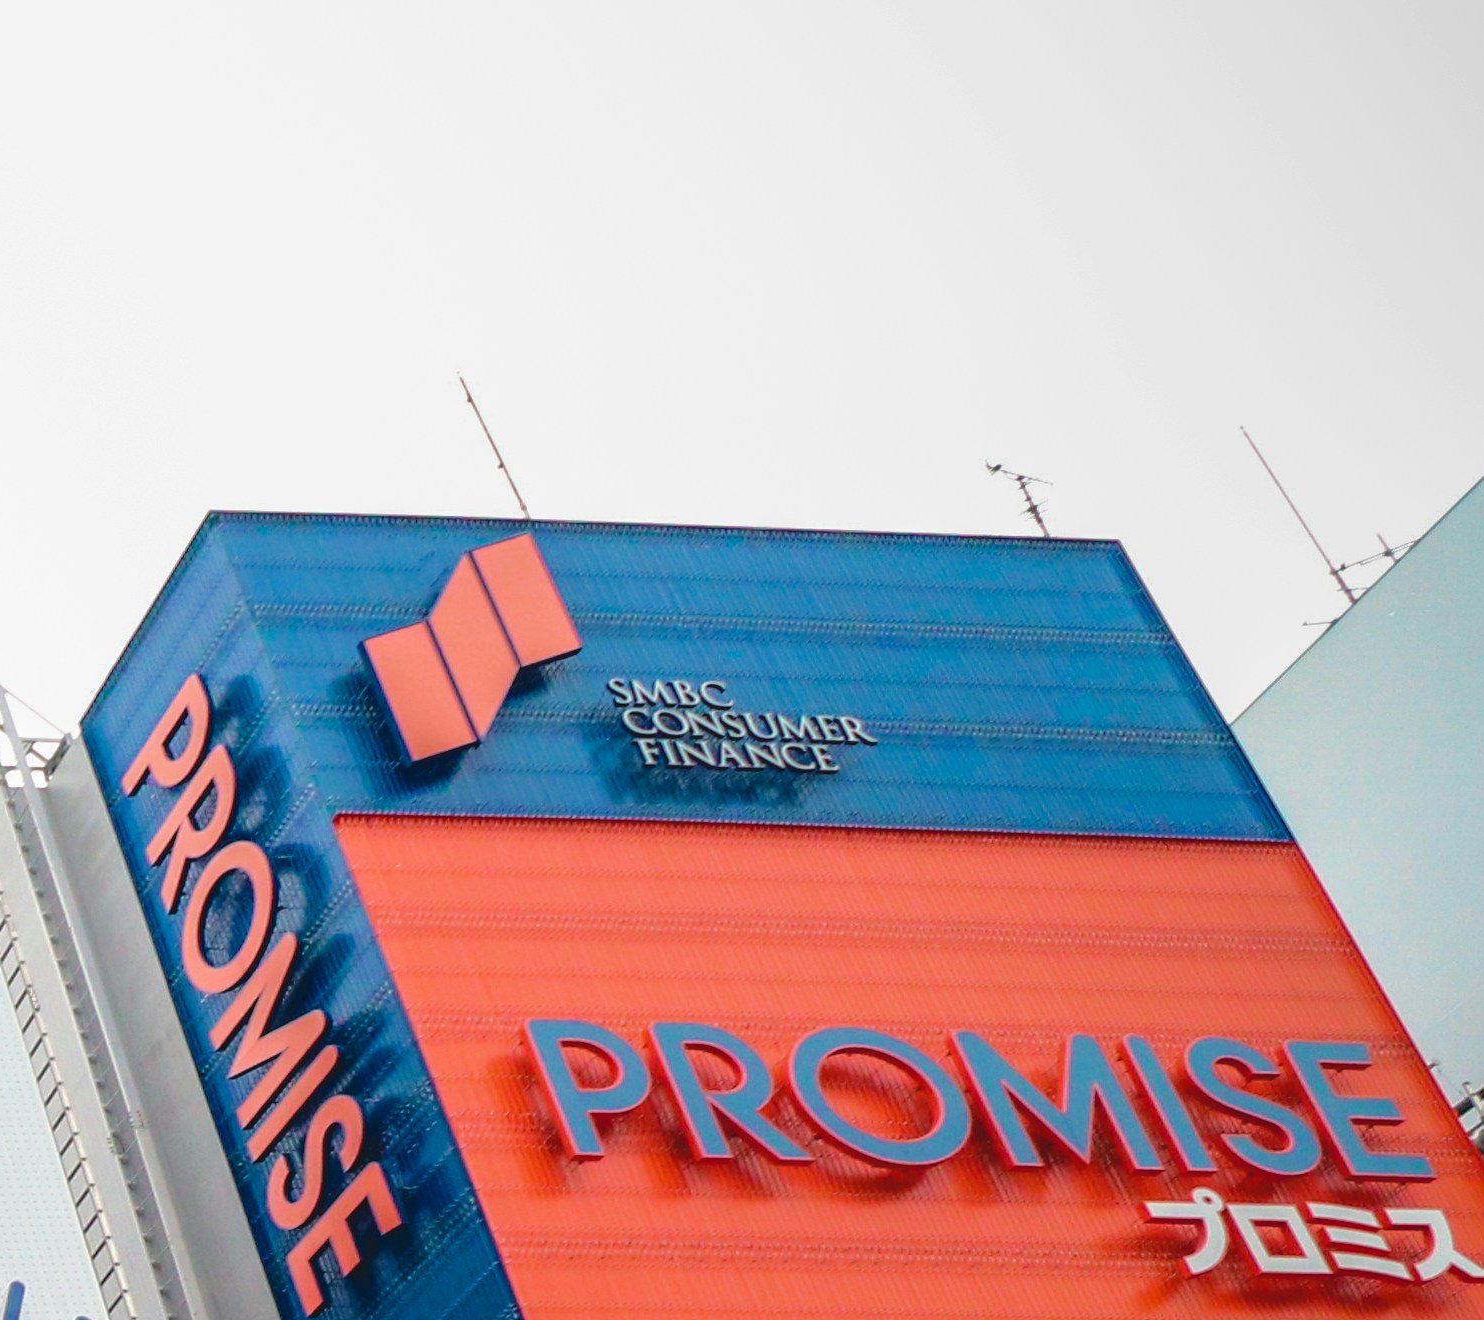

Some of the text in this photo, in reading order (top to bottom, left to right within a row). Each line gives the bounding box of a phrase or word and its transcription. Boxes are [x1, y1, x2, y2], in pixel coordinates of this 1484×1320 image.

[607, 676, 732, 712] SMBC
[621, 703, 879, 749] CONSUMER
[635, 735, 840, 776] FINANCE
[524, 1017, 1440, 1184] PROMISE
[1145, 1187, 1484, 1286] プロミス
